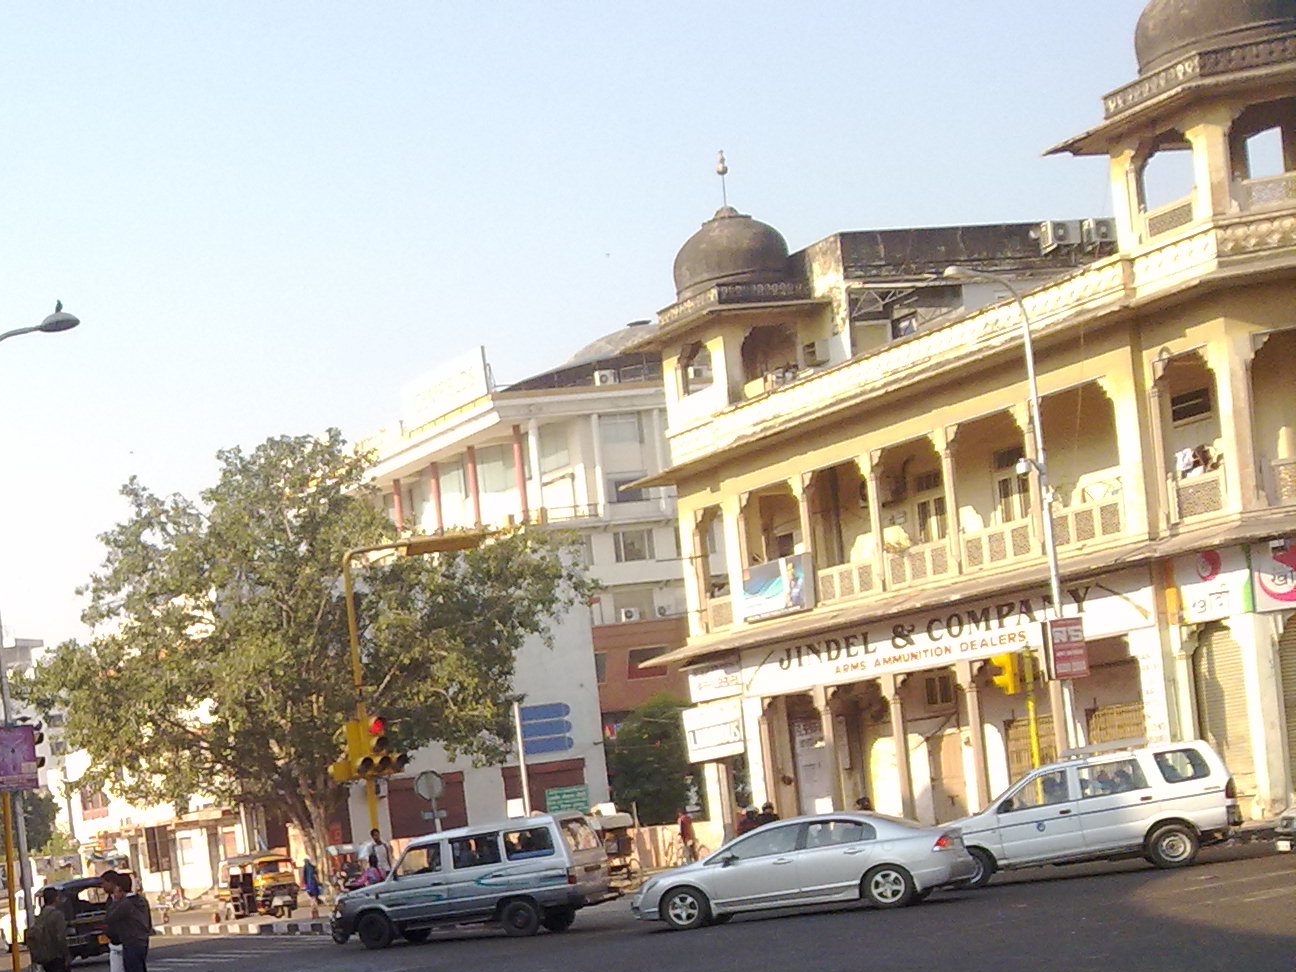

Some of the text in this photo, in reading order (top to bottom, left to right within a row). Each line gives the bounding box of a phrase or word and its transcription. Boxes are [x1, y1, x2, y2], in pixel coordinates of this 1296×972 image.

[779, 631, 878, 671] JINDEL
[891, 622, 916, 649] &
[835, 661, 866, 675] ARMS
[873, 645, 952, 666] AMMUNITION
[960, 630, 1027, 652] DEALERS
